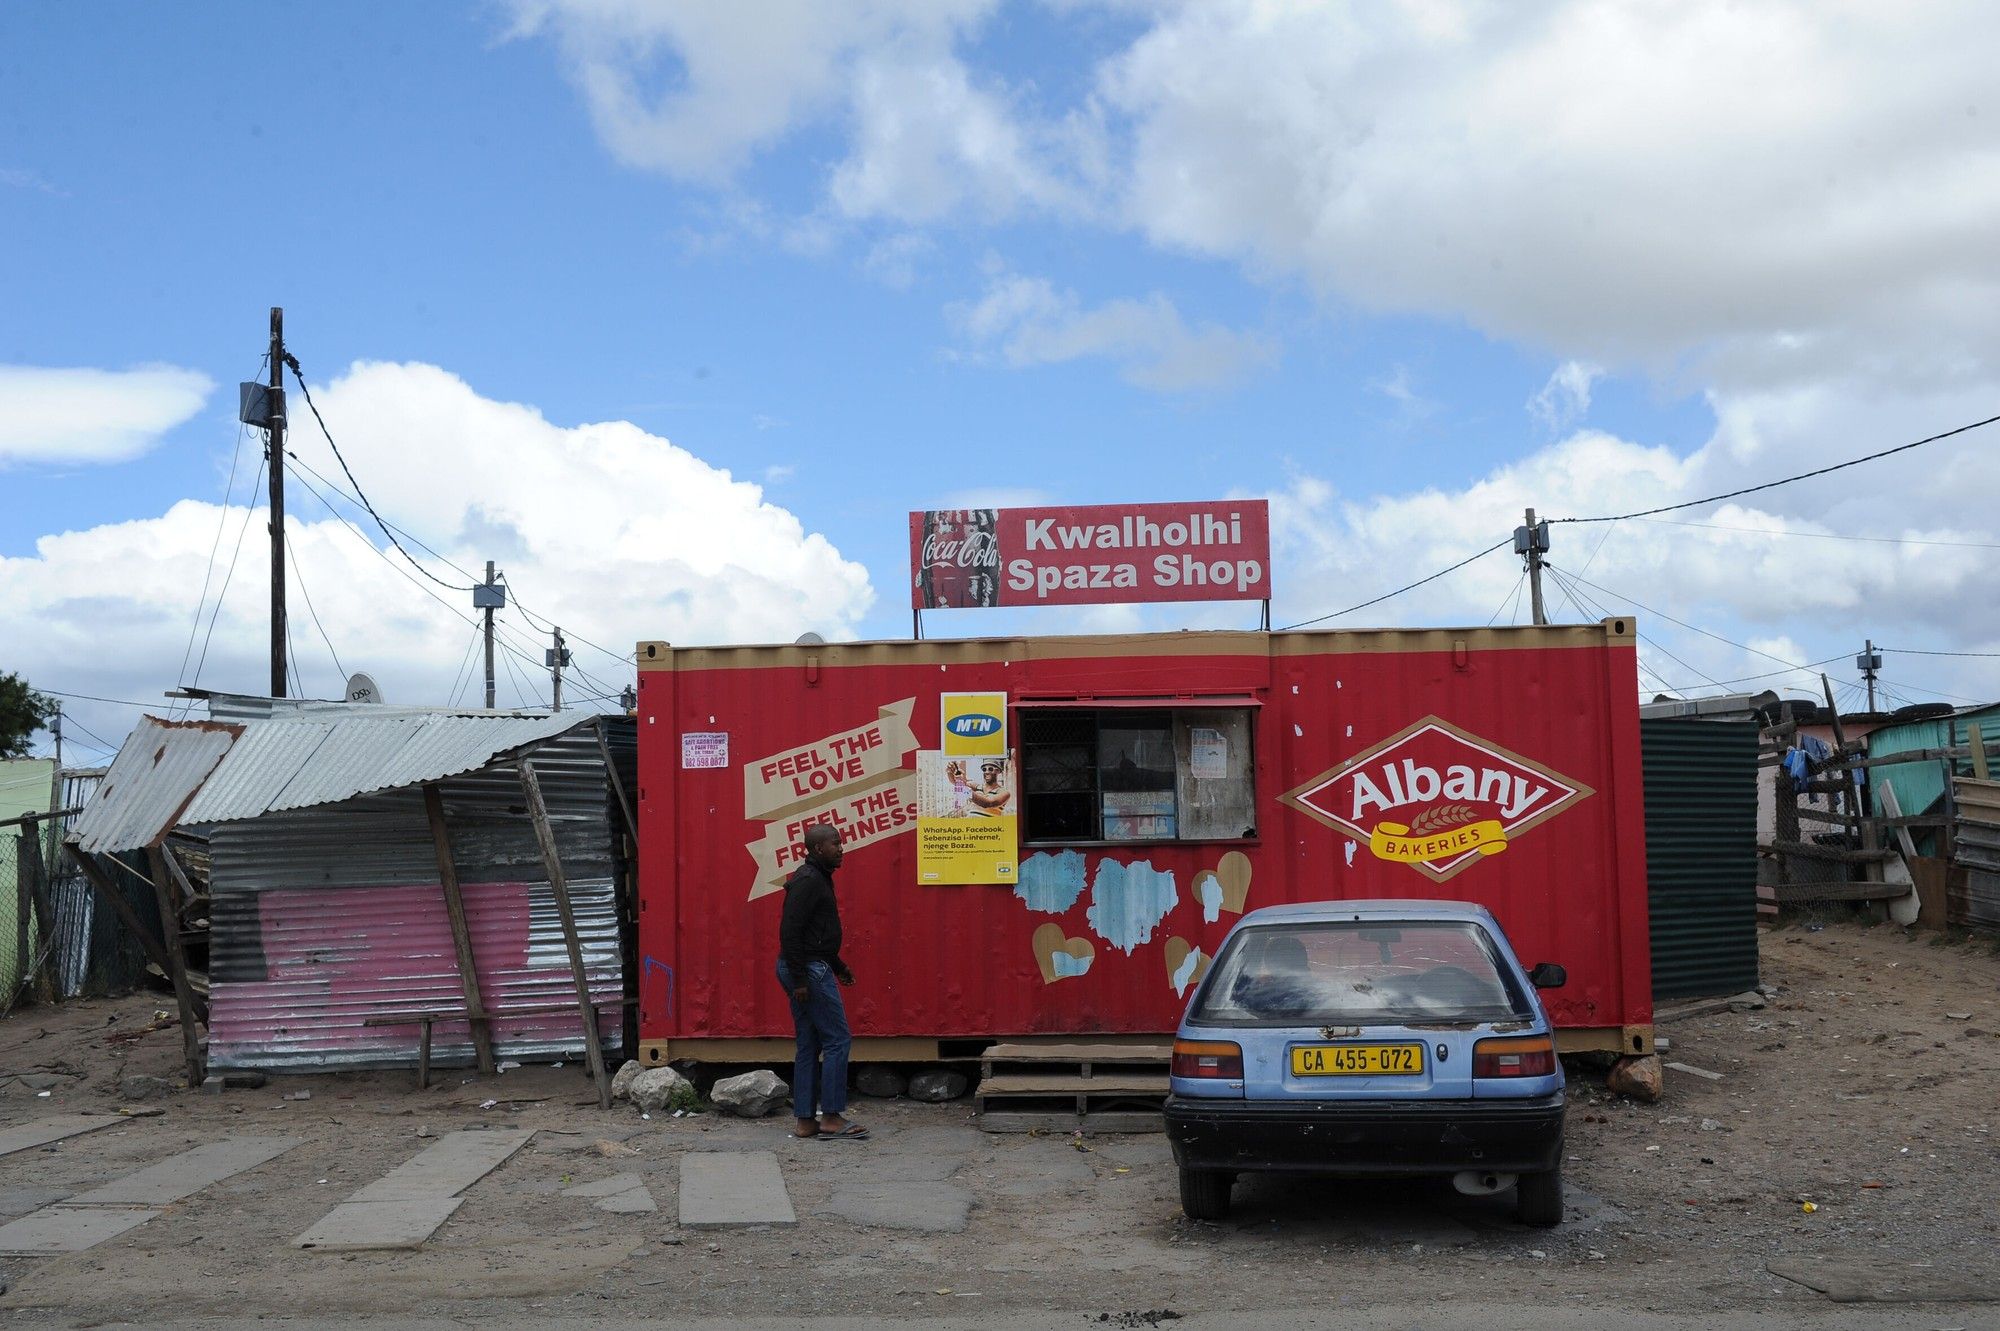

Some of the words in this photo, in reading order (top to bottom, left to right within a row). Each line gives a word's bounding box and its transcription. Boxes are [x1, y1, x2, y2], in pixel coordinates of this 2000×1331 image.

[922, 532, 997, 569] Coca-Cola
[1025, 512, 1241, 551] Kwalholhi
[1008, 559, 1138, 598] Spaza
[1153, 554, 1262, 592] Shop
[956, 718, 992, 732] MTN
[760, 749, 827, 785] FEEL
[828, 727, 883, 760] THE
[791, 757, 865, 797] LOVE
[1351, 758, 1549, 820] Albany
[850, 787, 900, 817] THE
[775, 802, 917, 868] FRHNESS
[1386, 829, 1481, 856] BAKERIES
[1303, 1051, 1325, 1071] CA
[1335, 1049, 1413, 1071] 455-072
